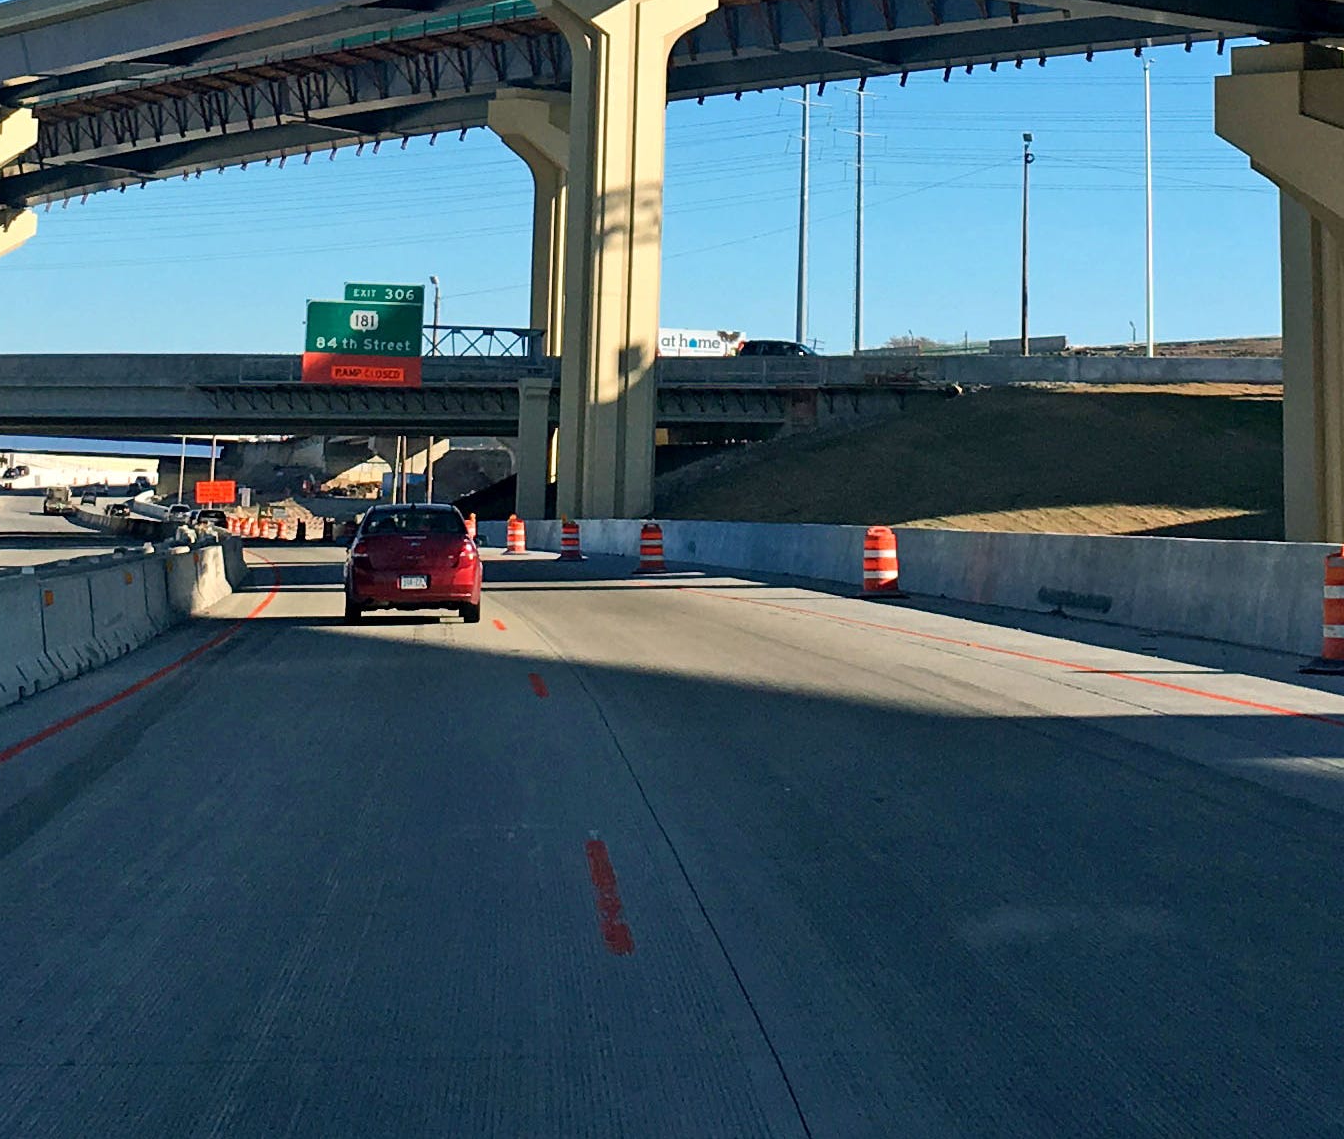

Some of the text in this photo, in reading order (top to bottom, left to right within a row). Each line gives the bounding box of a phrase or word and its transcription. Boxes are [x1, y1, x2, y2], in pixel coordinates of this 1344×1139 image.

[353, 289, 415, 301] EXIT 306
[355, 314, 375, 327] 181
[363, 339, 411, 351] Street
[661, 335, 676, 347] at
[335, 368, 401, 379] RAMP CLOSED
